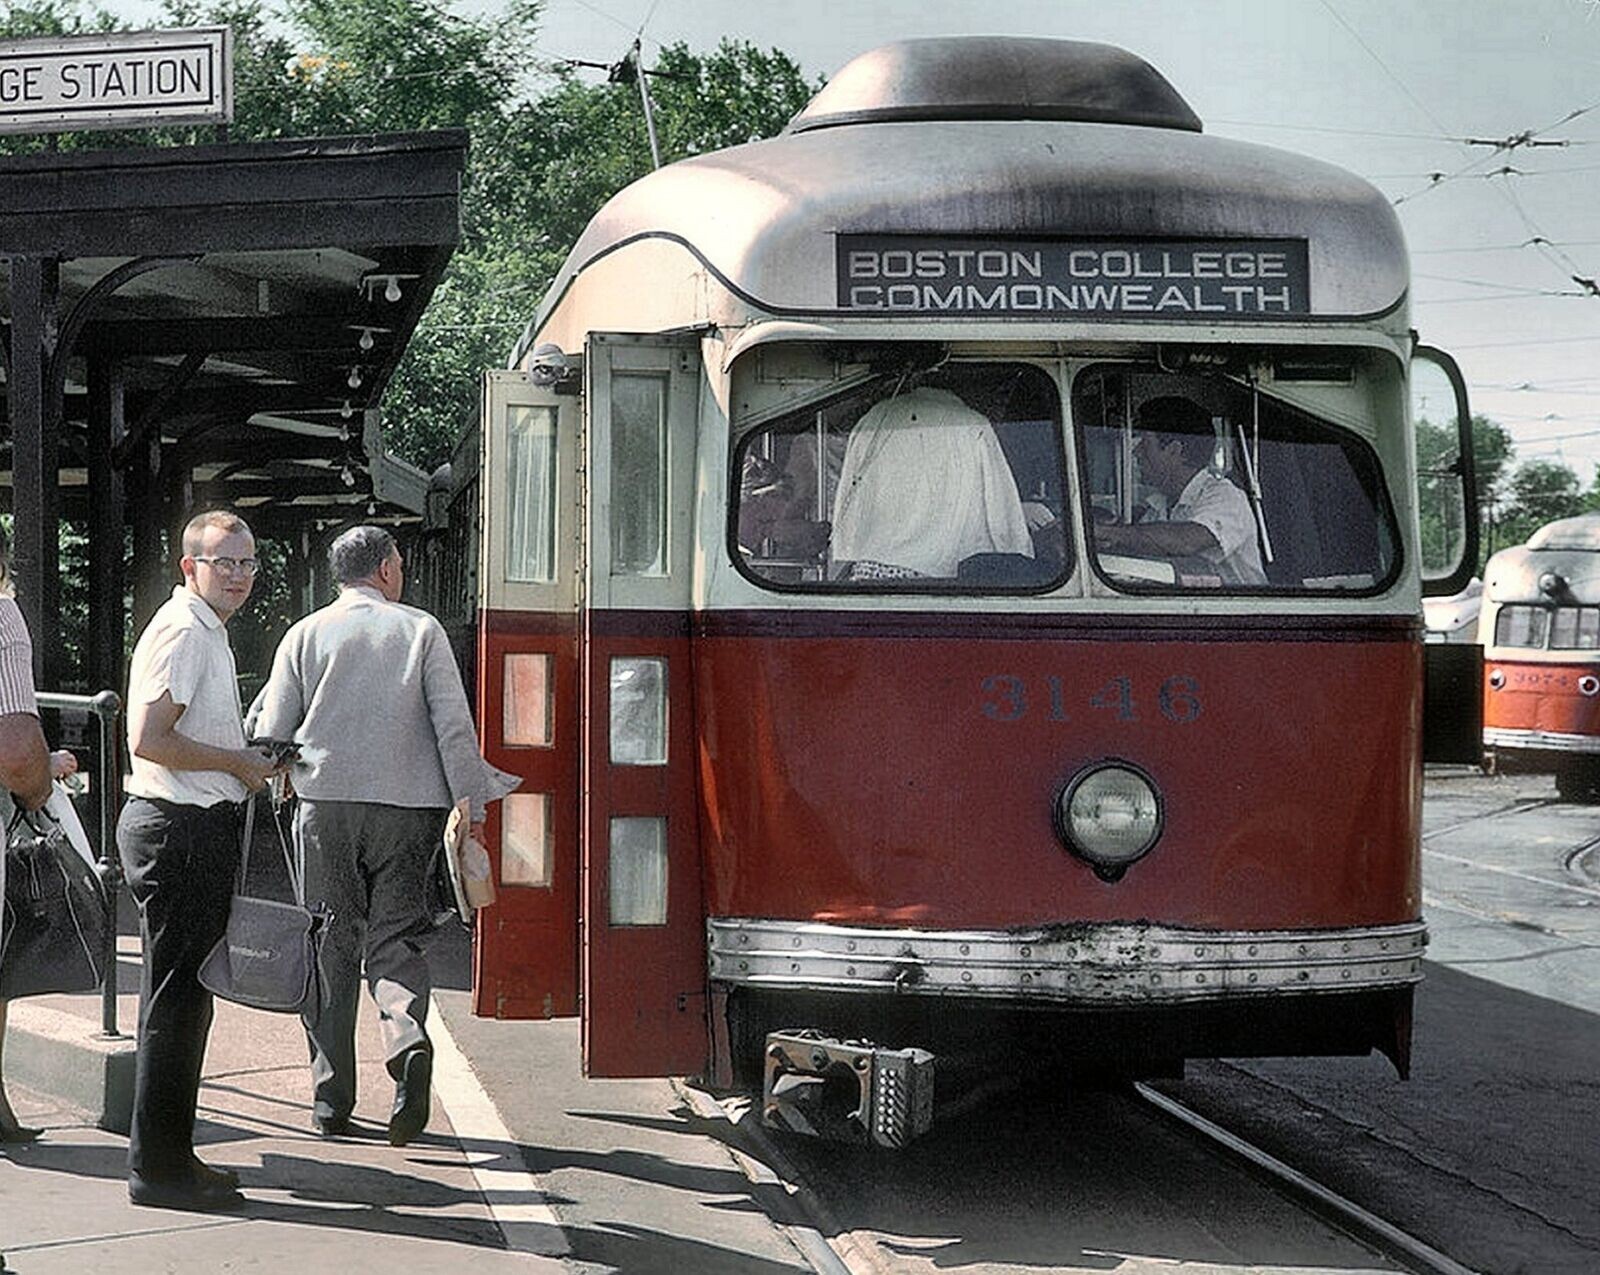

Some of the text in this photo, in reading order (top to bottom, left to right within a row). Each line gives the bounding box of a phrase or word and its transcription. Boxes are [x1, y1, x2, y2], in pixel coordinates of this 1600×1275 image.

[0, 57, 202, 102] GE STATION
[850, 251, 1288, 278] BOSTON COLLEGE
[850, 284, 1290, 312] COMMONWEALTH
[980, 674, 1203, 723] 3146
